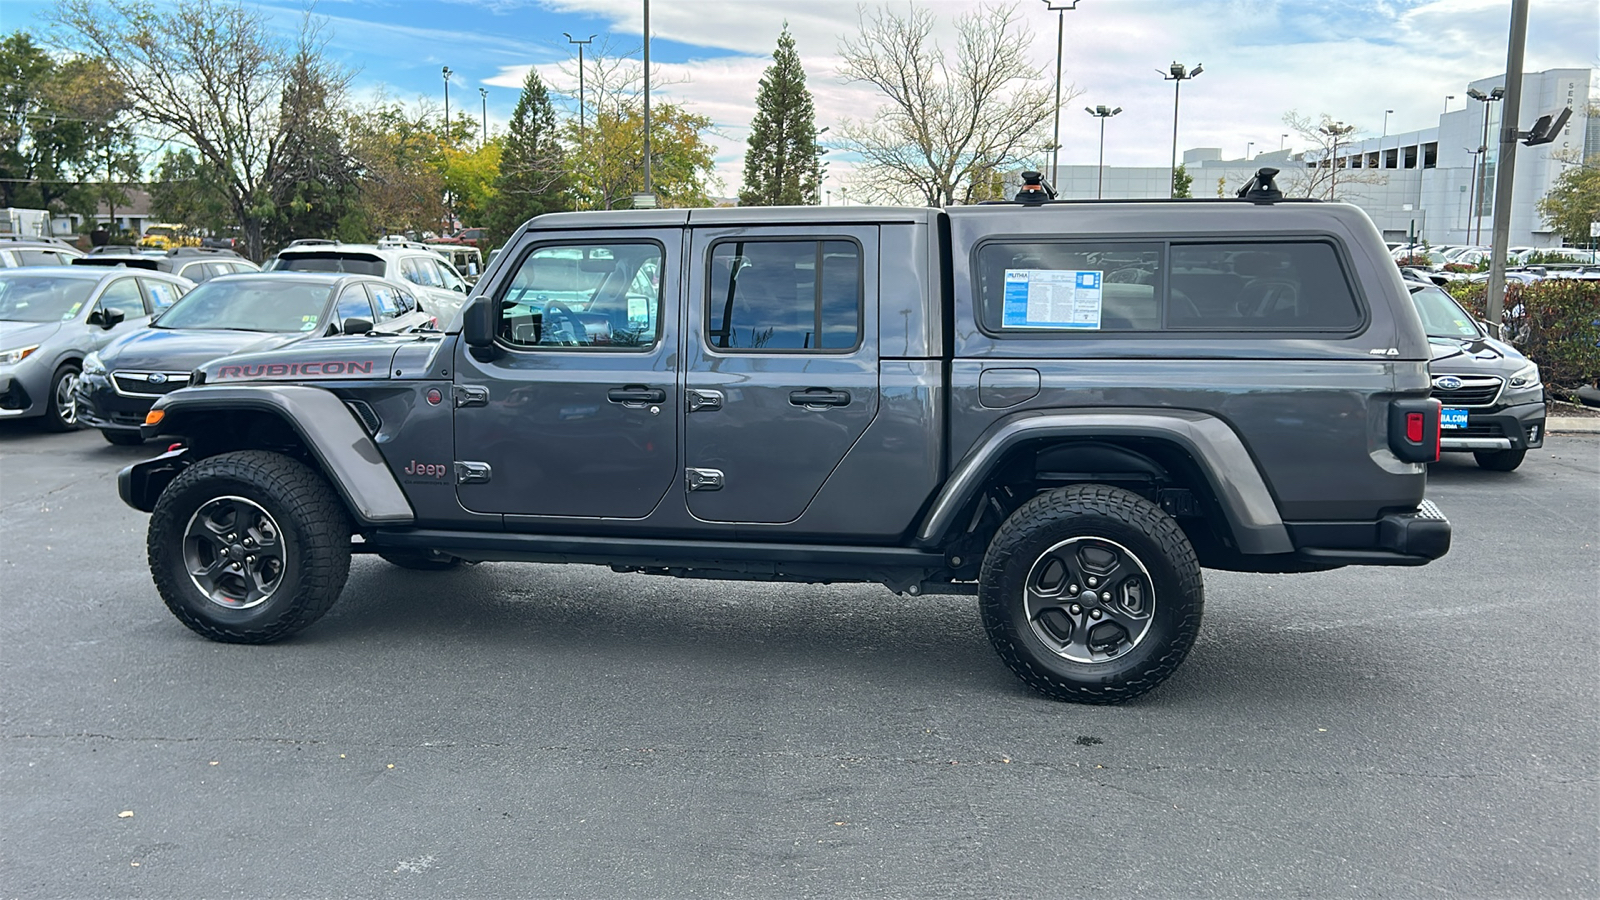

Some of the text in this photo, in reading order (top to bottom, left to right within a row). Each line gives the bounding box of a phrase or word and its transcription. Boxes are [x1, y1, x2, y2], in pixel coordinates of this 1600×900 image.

[1564, 82, 1575, 135] SERCE
[217, 361, 374, 379] RUBICON
[404, 459, 446, 479] Jeep
